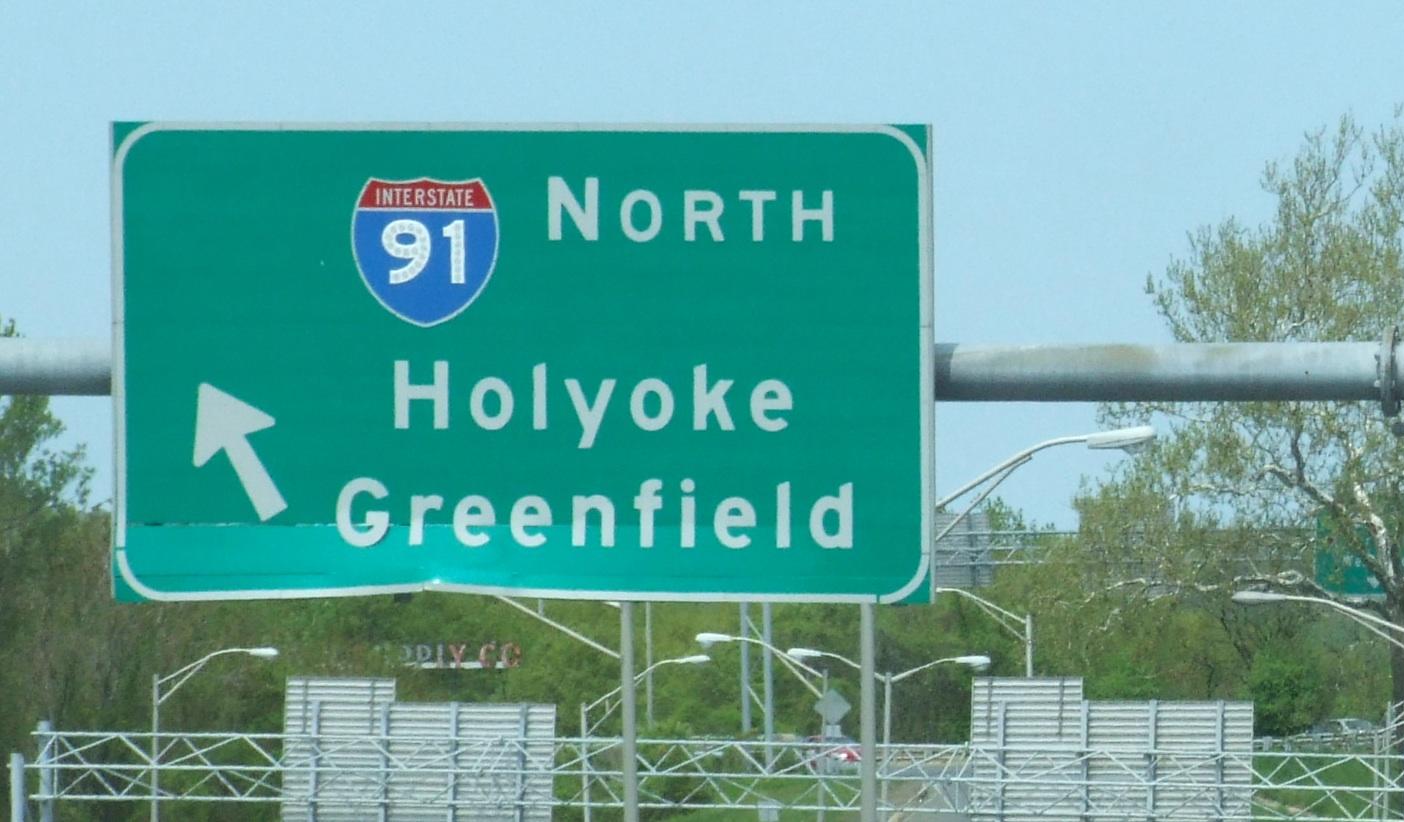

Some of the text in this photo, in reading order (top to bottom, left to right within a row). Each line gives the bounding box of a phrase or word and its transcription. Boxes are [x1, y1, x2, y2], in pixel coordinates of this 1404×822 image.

[375, 187, 475, 207] INTERSTATE
[548, 177, 834, 242] NORTH
[381, 218, 466, 285] 91
[394, 360, 793, 449] Holyoke
[337, 478, 853, 549] Greenfield
